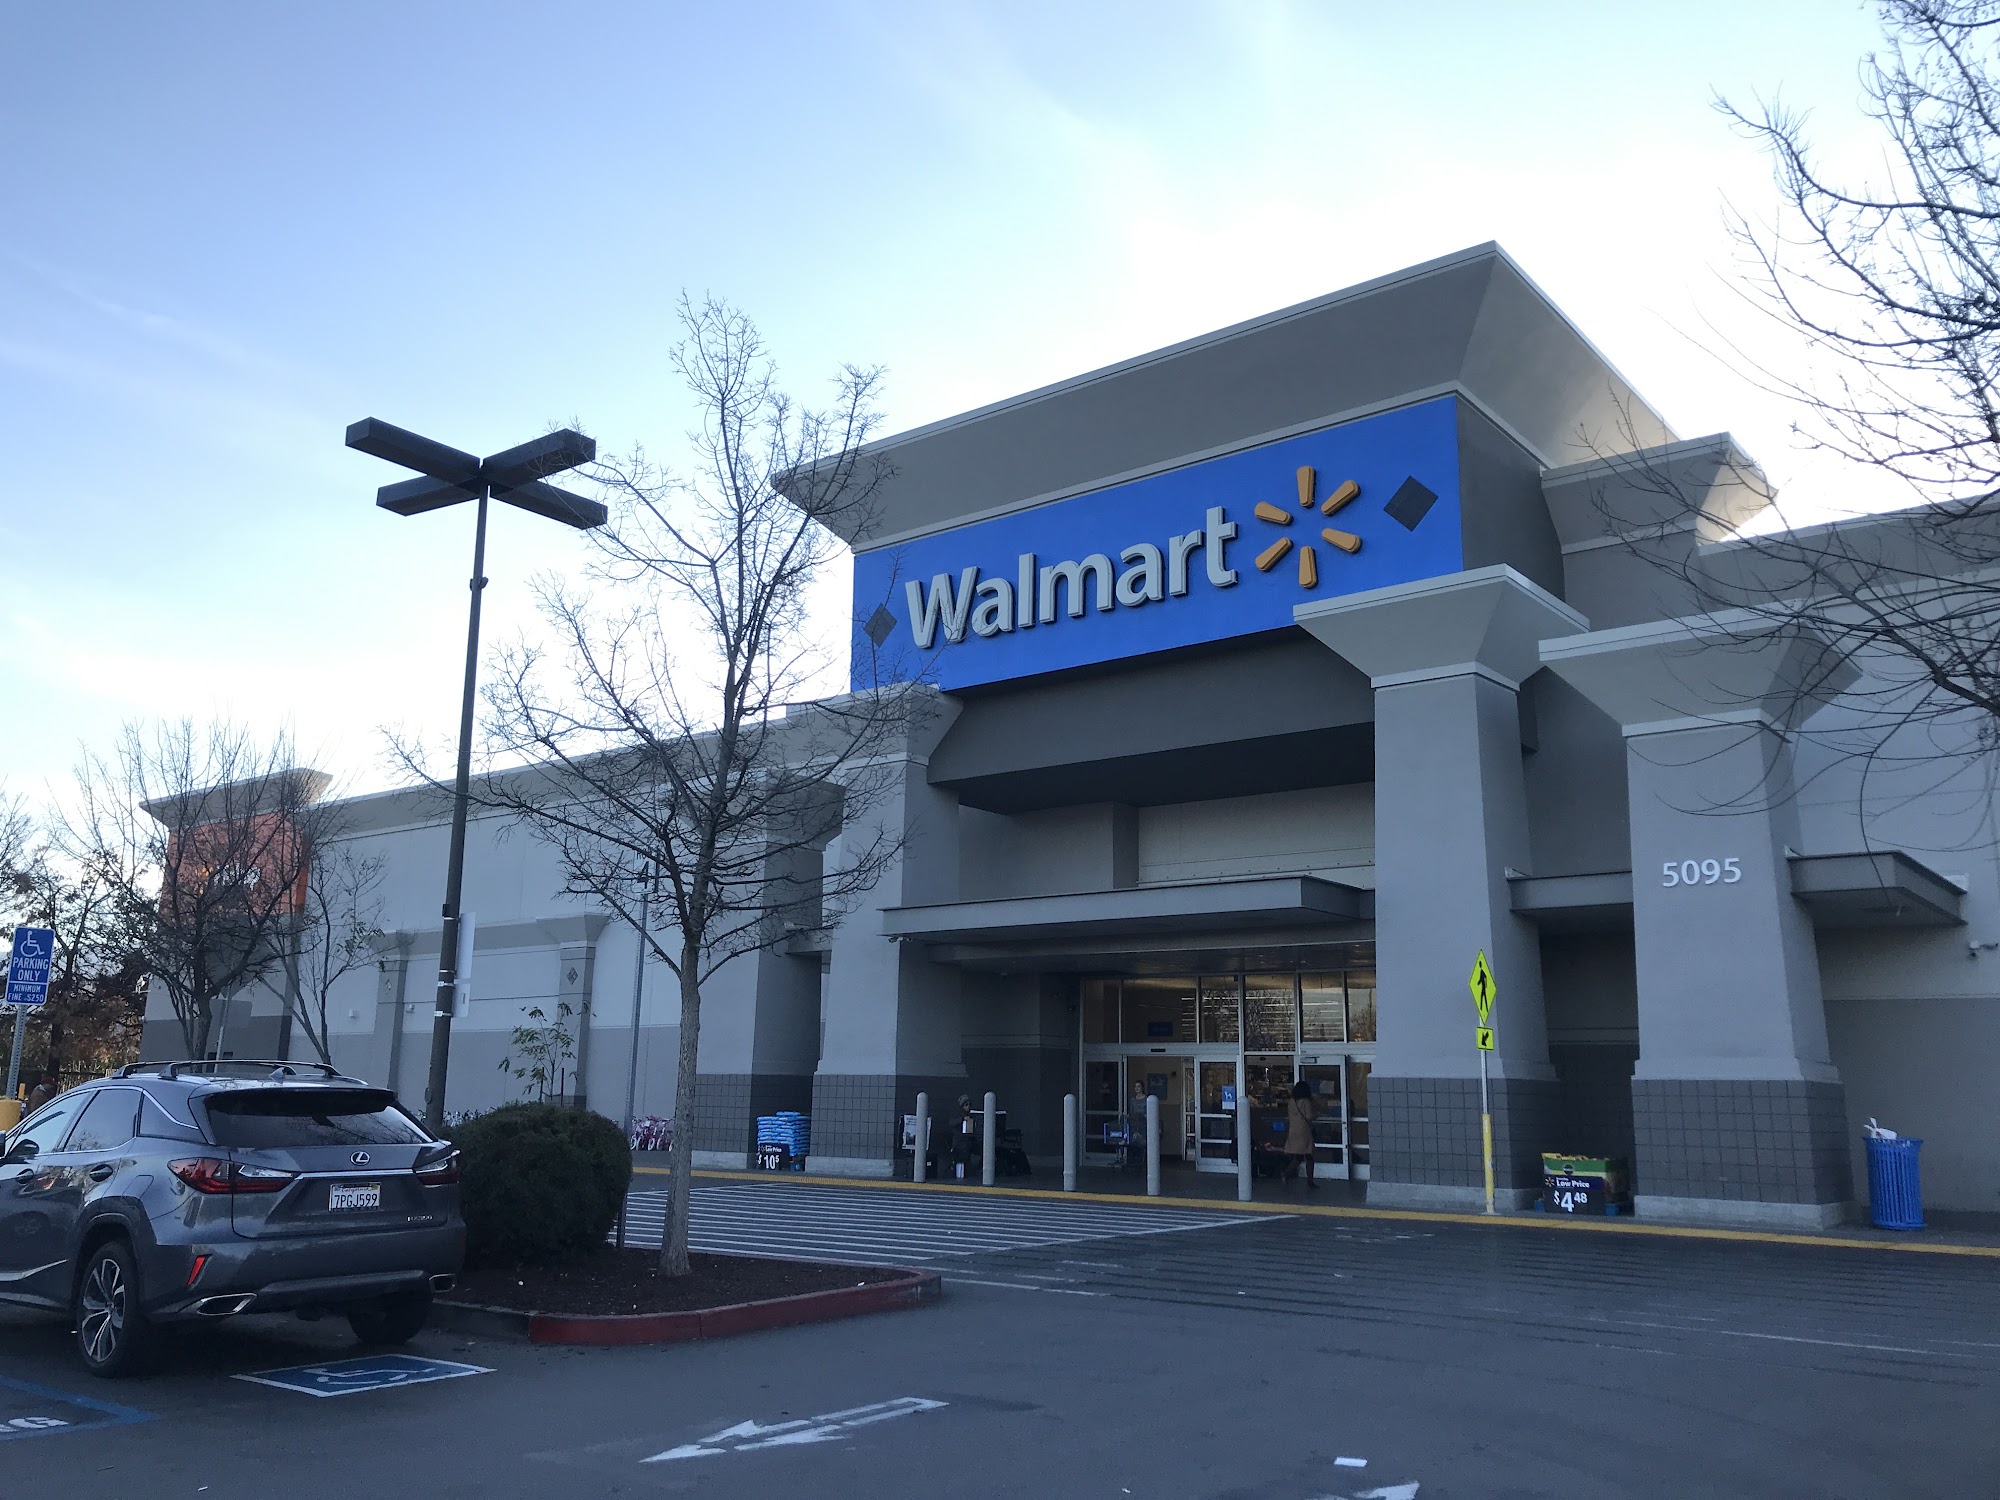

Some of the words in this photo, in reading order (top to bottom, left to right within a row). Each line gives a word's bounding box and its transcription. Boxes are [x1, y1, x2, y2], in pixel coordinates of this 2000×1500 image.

[905, 506, 1239, 650] Walmart
[1662, 857, 1742, 887] 5095
[12, 956, 49, 970] PARKING
[17, 969, 41, 982] ONLY
[13, 984, 41, 993] MINIMUM
[7, 992, 22, 1001] FINE
[1556, 1180, 1571, 1188] Low
[1571, 1180, 1590, 1189] Price
[334, 1193, 378, 1209] 7PGJ599
